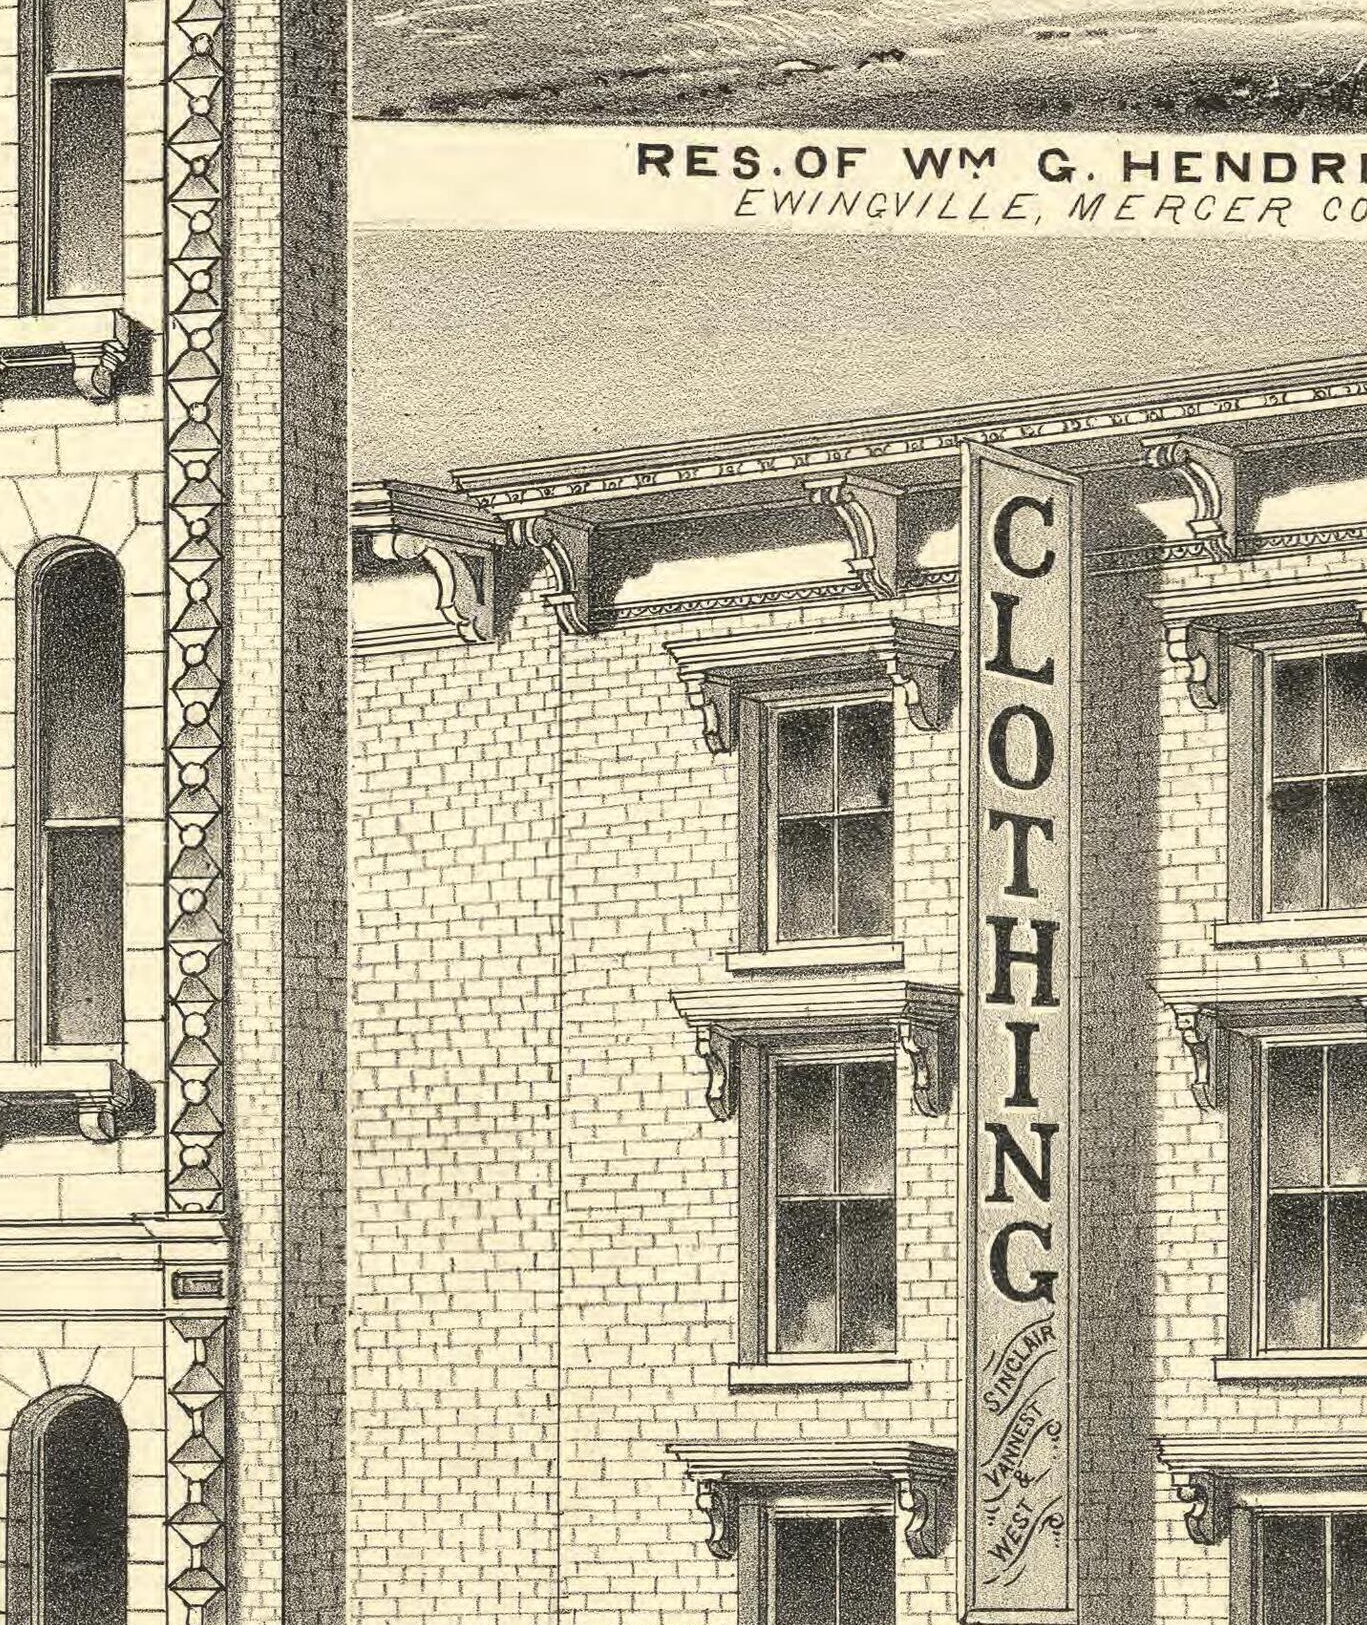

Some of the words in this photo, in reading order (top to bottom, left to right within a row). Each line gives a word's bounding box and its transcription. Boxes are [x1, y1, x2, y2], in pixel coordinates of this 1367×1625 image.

[1037, 147, 1094, 183] G.
[734, 188, 1041, 226] EWINGVILLE,
[1068, 193, 1292, 227] MERCER
[985, 495, 1060, 1304] CLOTHING
[983, 1324, 1056, 1413] SINCLAIR
[985, 1400, 1044, 1487] VANNEST
[1014, 1469, 1034, 1489] &
[987, 1497, 1035, 1563] WEST
